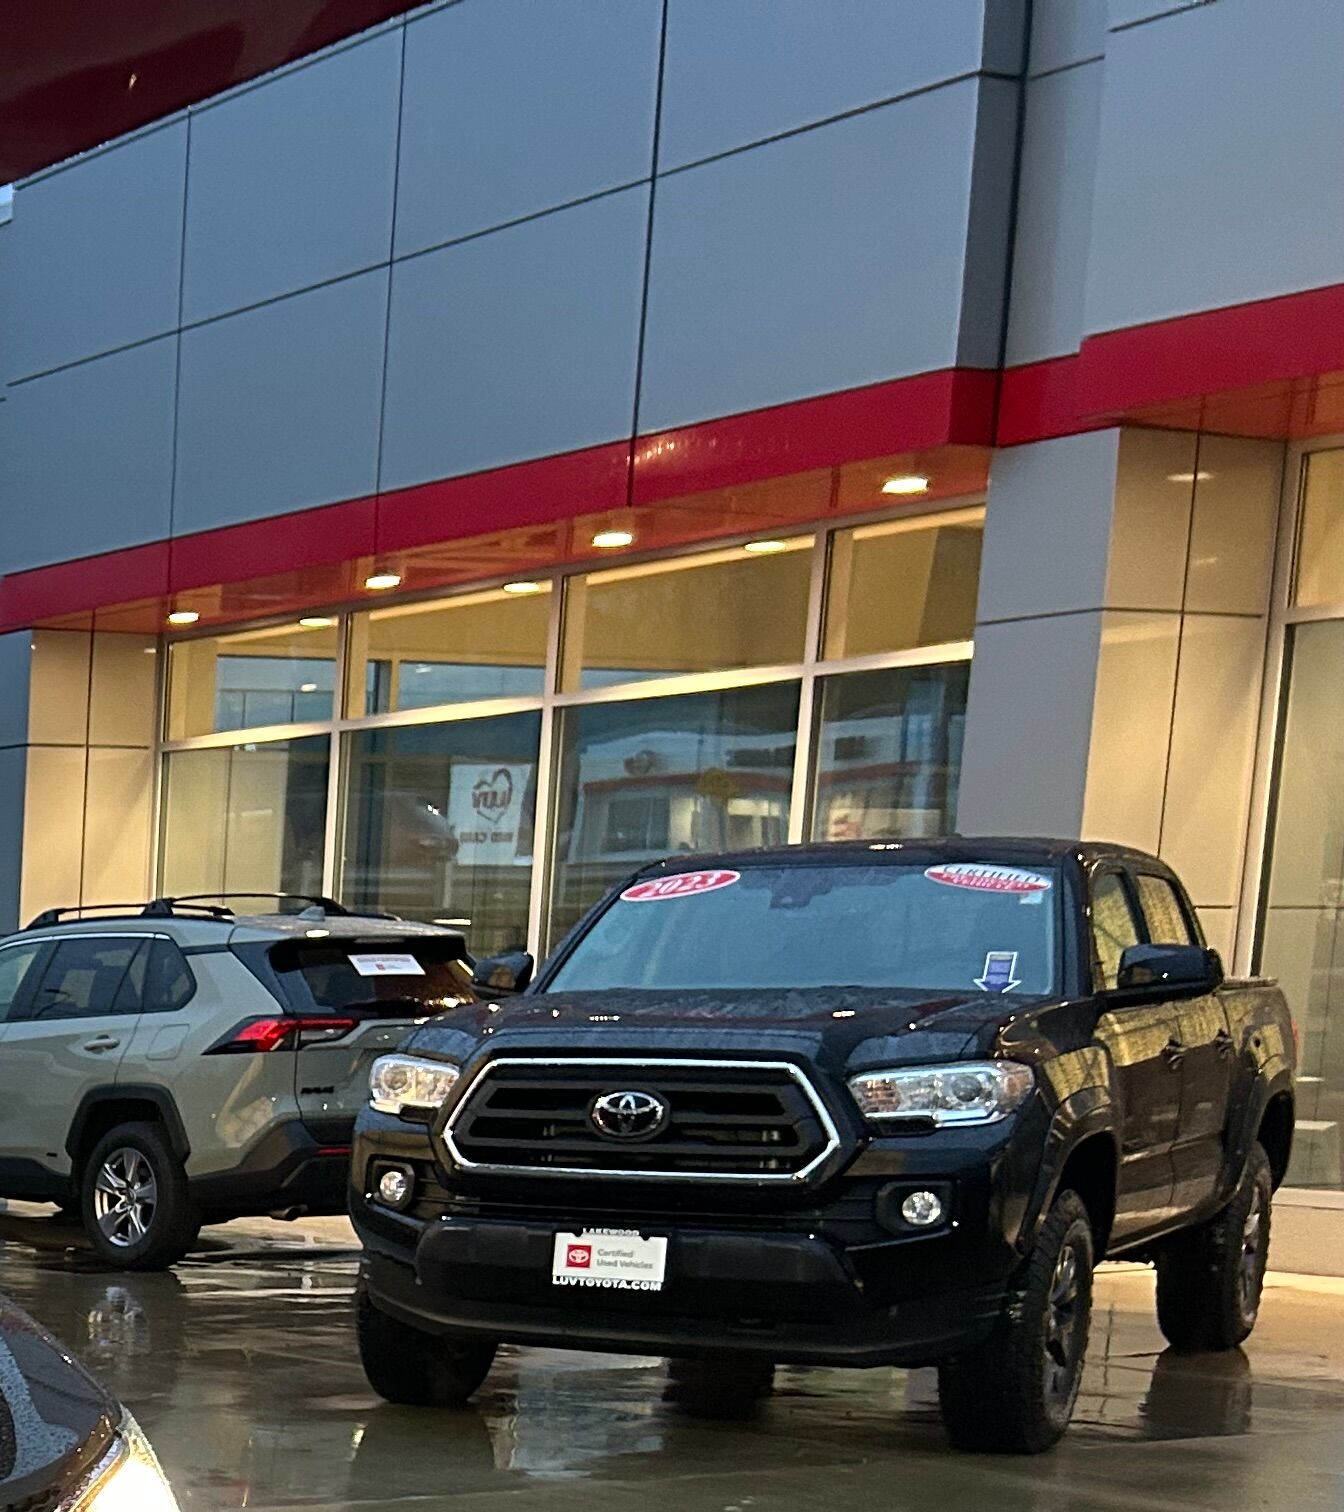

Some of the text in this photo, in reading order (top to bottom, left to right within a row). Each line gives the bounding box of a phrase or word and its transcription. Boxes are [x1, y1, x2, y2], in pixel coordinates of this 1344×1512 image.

[597, 1248, 635, 1258] Certified
[596, 1259, 654, 1270] Used Vehicles
[552, 1275, 662, 1292] LUVTOYOTA.COM
